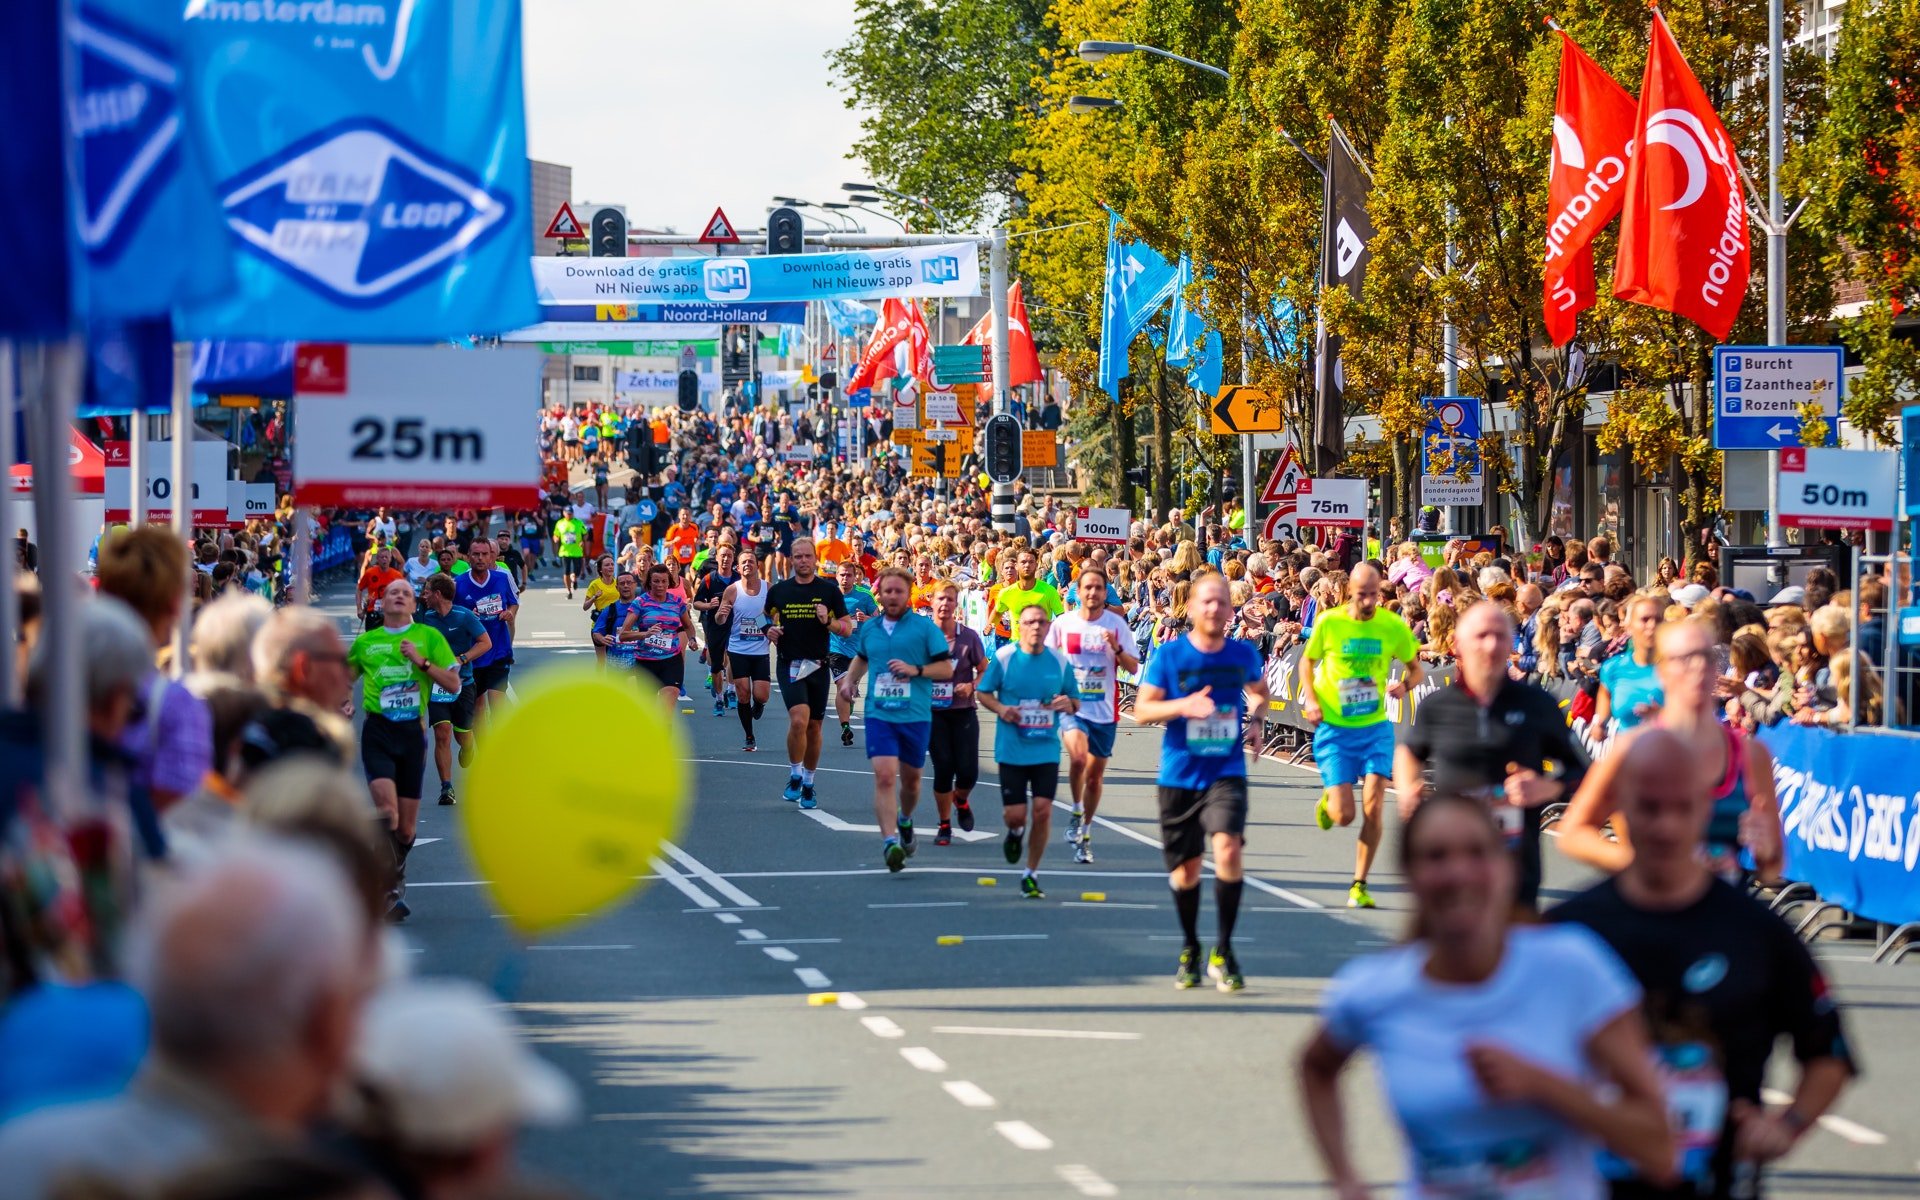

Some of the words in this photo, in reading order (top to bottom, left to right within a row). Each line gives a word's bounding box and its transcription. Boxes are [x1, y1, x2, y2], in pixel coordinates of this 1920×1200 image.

[380, 202, 464, 229] LOOP
[783, 260, 850, 273] Download
[854, 259, 870, 271] de
[874, 257, 912, 272] gratis
[925, 259, 957, 279] NH
[566, 266, 634, 277] Download
[638, 266, 655, 277] de
[659, 265, 698, 279] gratis
[711, 267, 745, 287] NH
[812, 277, 833, 289] NH
[836, 275, 885, 288] Nieuws
[889, 275, 913, 289] app
[595, 283, 616, 294] NH
[620, 282, 670, 294] Nieuws
[673, 283, 698, 296] app
[663, 309, 768, 322] Noord-Holland
[1745, 358, 1793, 370] Burcht
[629, 375, 649, 387] Zet
[1744, 378, 1834, 391] Zaanthear
[351, 416, 484, 460] 25m
[1424, 487, 1480, 495] donderdagavond
[1802, 483, 1868, 507] 50m
[246, 499, 267, 510] 0m
[1311, 500, 1349, 514] 75m
[1084, 523, 1120, 535] 100m
[1423, 546, 1434, 555] ZA
[649, 637, 667, 647] 5435
[389, 697, 413, 709] 7909
